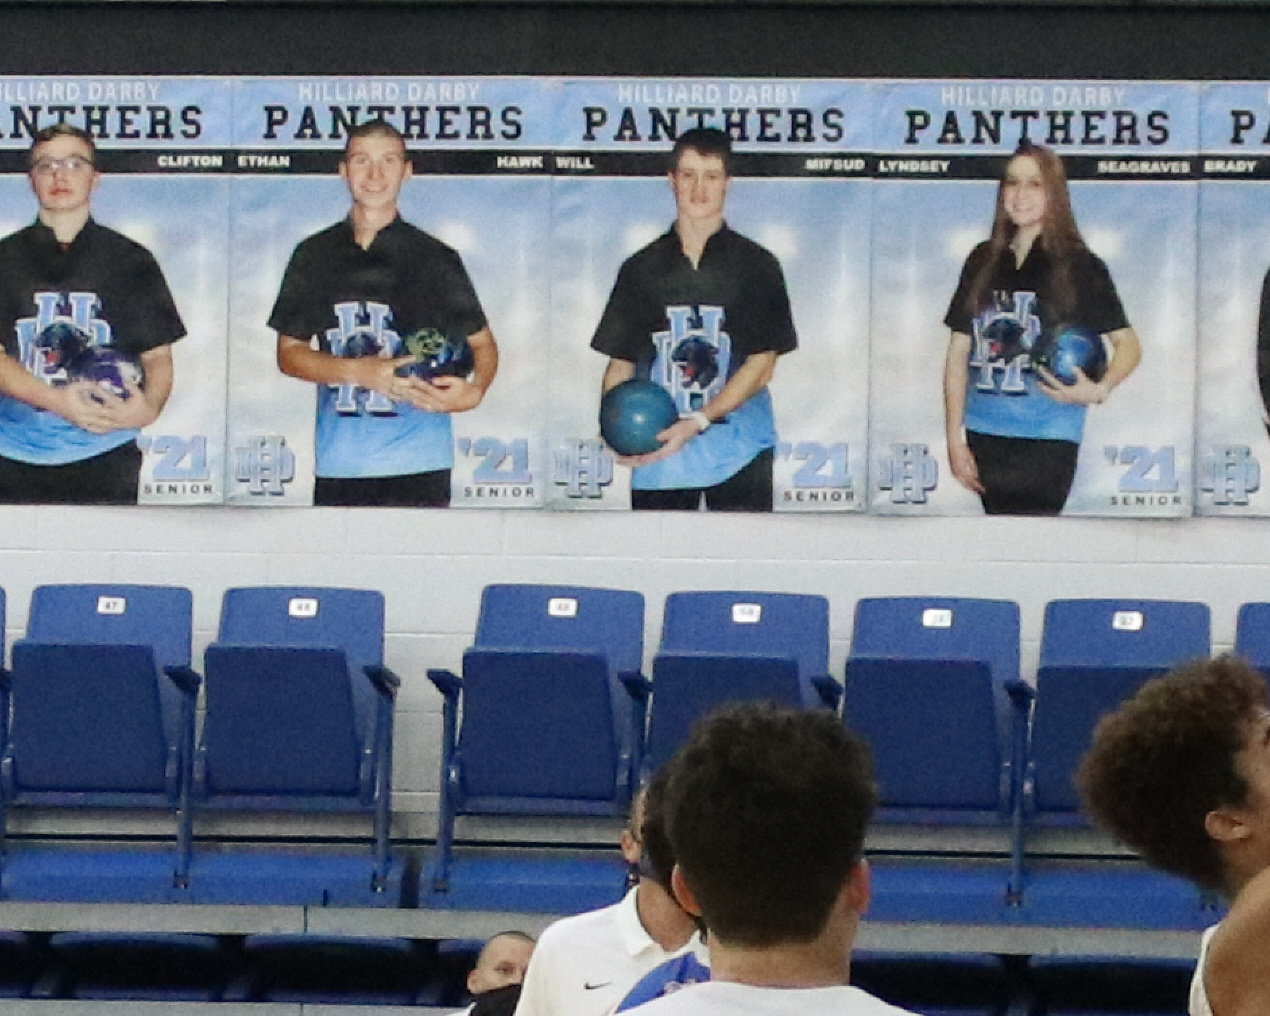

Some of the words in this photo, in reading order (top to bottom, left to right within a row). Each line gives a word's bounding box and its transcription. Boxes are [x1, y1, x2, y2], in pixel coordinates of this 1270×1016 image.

[88, 82, 160, 101] DARBY
[299, 82, 399, 102] HILLIARD
[408, 82, 479, 102] DARBY
[617, 83, 720, 103] HILLIARD
[729, 83, 800, 103] DARBY
[941, 86, 1043, 107] HILLIARD
[1053, 88, 1126, 107] DARBY
[0, 105, 202, 139] NTHERS
[263, 105, 522, 140] PANTHERS
[582, 106, 845, 142] PANTHERS
[904, 109, 1171, 145] PANTHERS
[157, 155, 222, 168] CLIFTON
[237, 155, 290, 168] ETHAN
[496, 156, 543, 169] HAWK
[555, 156, 594, 169] WILL
[879, 160, 950, 172] LYNDSEY
[1203, 160, 1257, 173] BRADY
[457, 437, 532, 485] '21
[1104, 445, 1178, 492] '21
[142, 483, 213, 494] SENIOR
[463, 486, 535, 498] SENIOR
[783, 490, 856, 502] SENIOR
[1110, 495, 1182, 506] SENIOR
